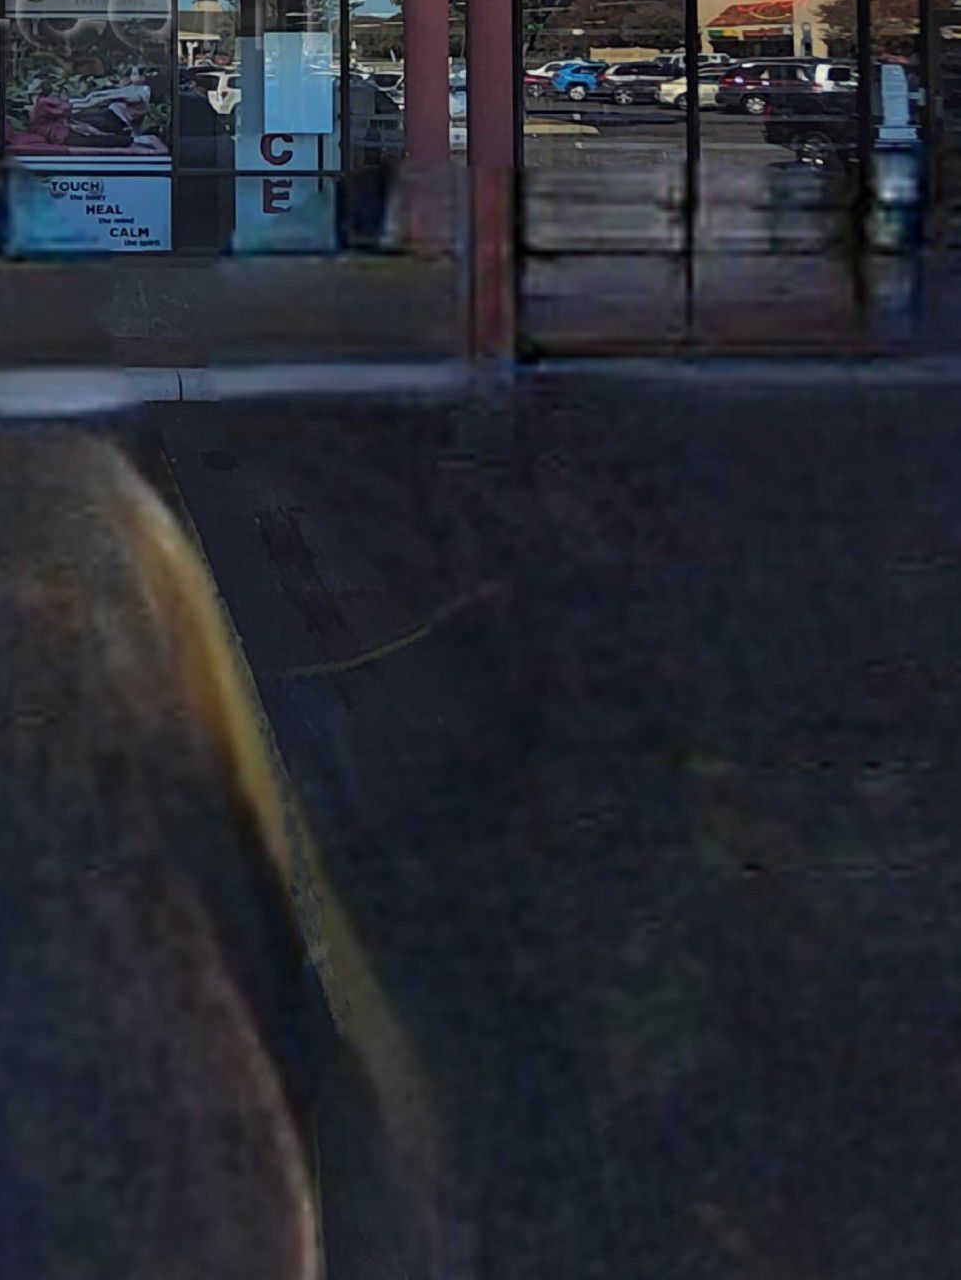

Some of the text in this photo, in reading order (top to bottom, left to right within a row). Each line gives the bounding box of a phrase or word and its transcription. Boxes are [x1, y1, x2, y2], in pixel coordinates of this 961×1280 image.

[51, 181, 100, 192] TOUCH
[86, 205, 123, 215] HEAL
[110, 228, 149, 237] CALM
